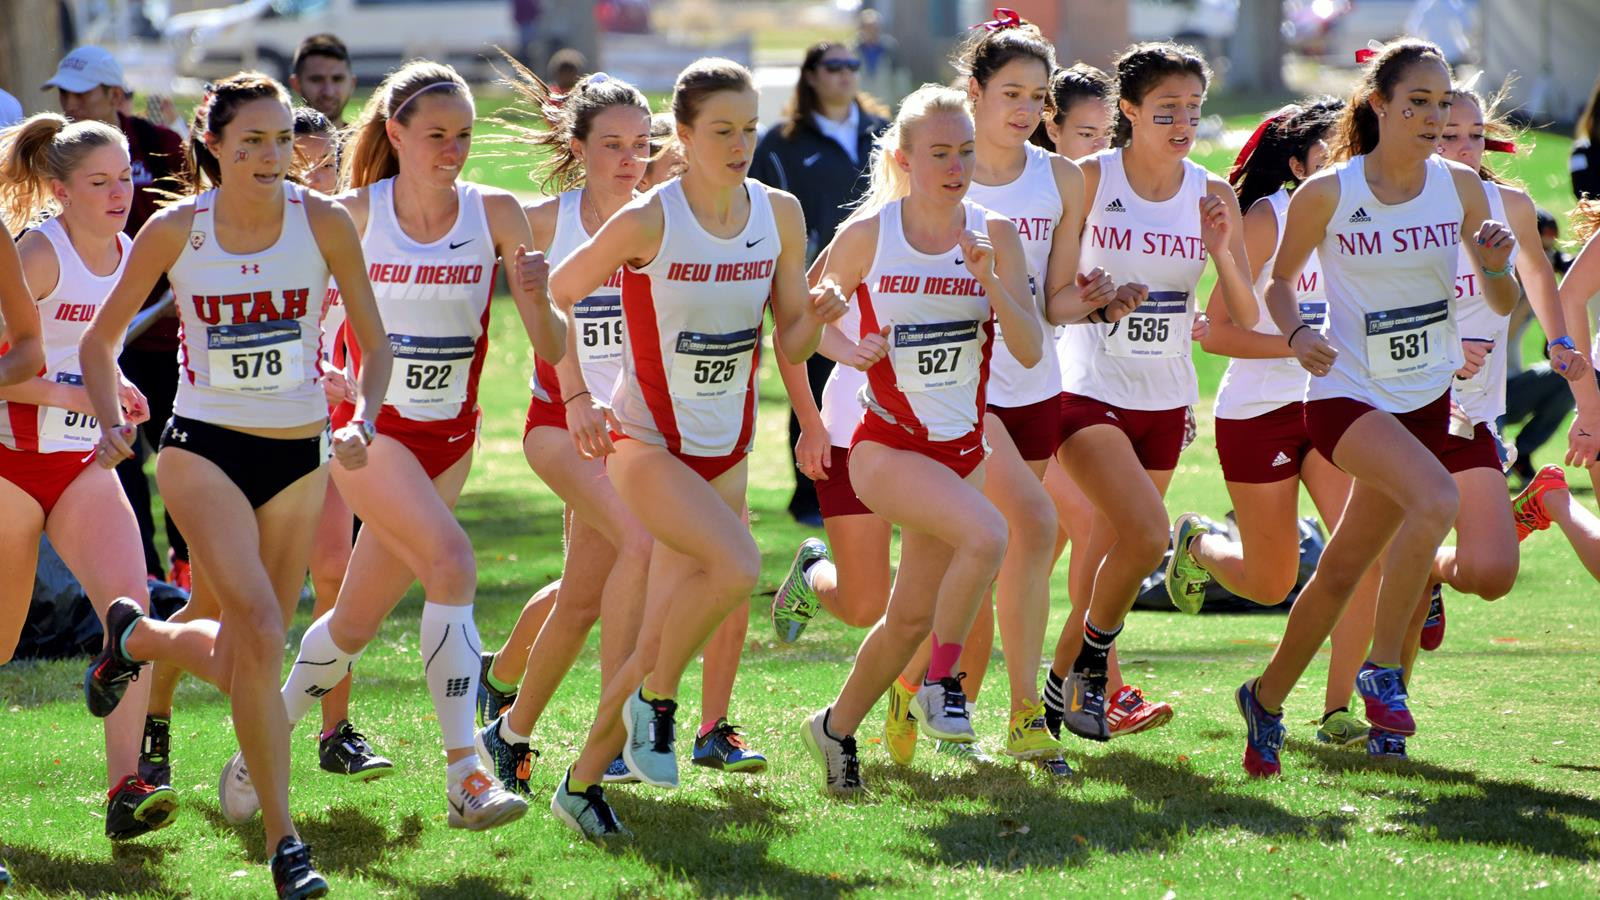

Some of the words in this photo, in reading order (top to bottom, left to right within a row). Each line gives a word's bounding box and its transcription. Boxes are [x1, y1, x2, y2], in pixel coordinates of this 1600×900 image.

[1091, 225, 1132, 251] NM
[1142, 231, 1206, 261] STATE
[1336, 230, 1382, 256] NM
[1392, 222, 1459, 253] STATE
[414, 264, 483, 285] MEXICO
[667, 262, 712, 282] NEW
[715, 259, 774, 282] MEXICO
[878, 275, 920, 294] NEW
[192, 287, 309, 326] UTAH
[583, 320, 622, 347] 519
[1127, 316, 1171, 343] 535
[1389, 330, 1429, 361] 531
[231, 349, 282, 379] 578
[694, 358, 738, 384] 525
[918, 346, 962, 376] 527
[406, 364, 453, 390] 522
[445, 690, 468, 698] cep
